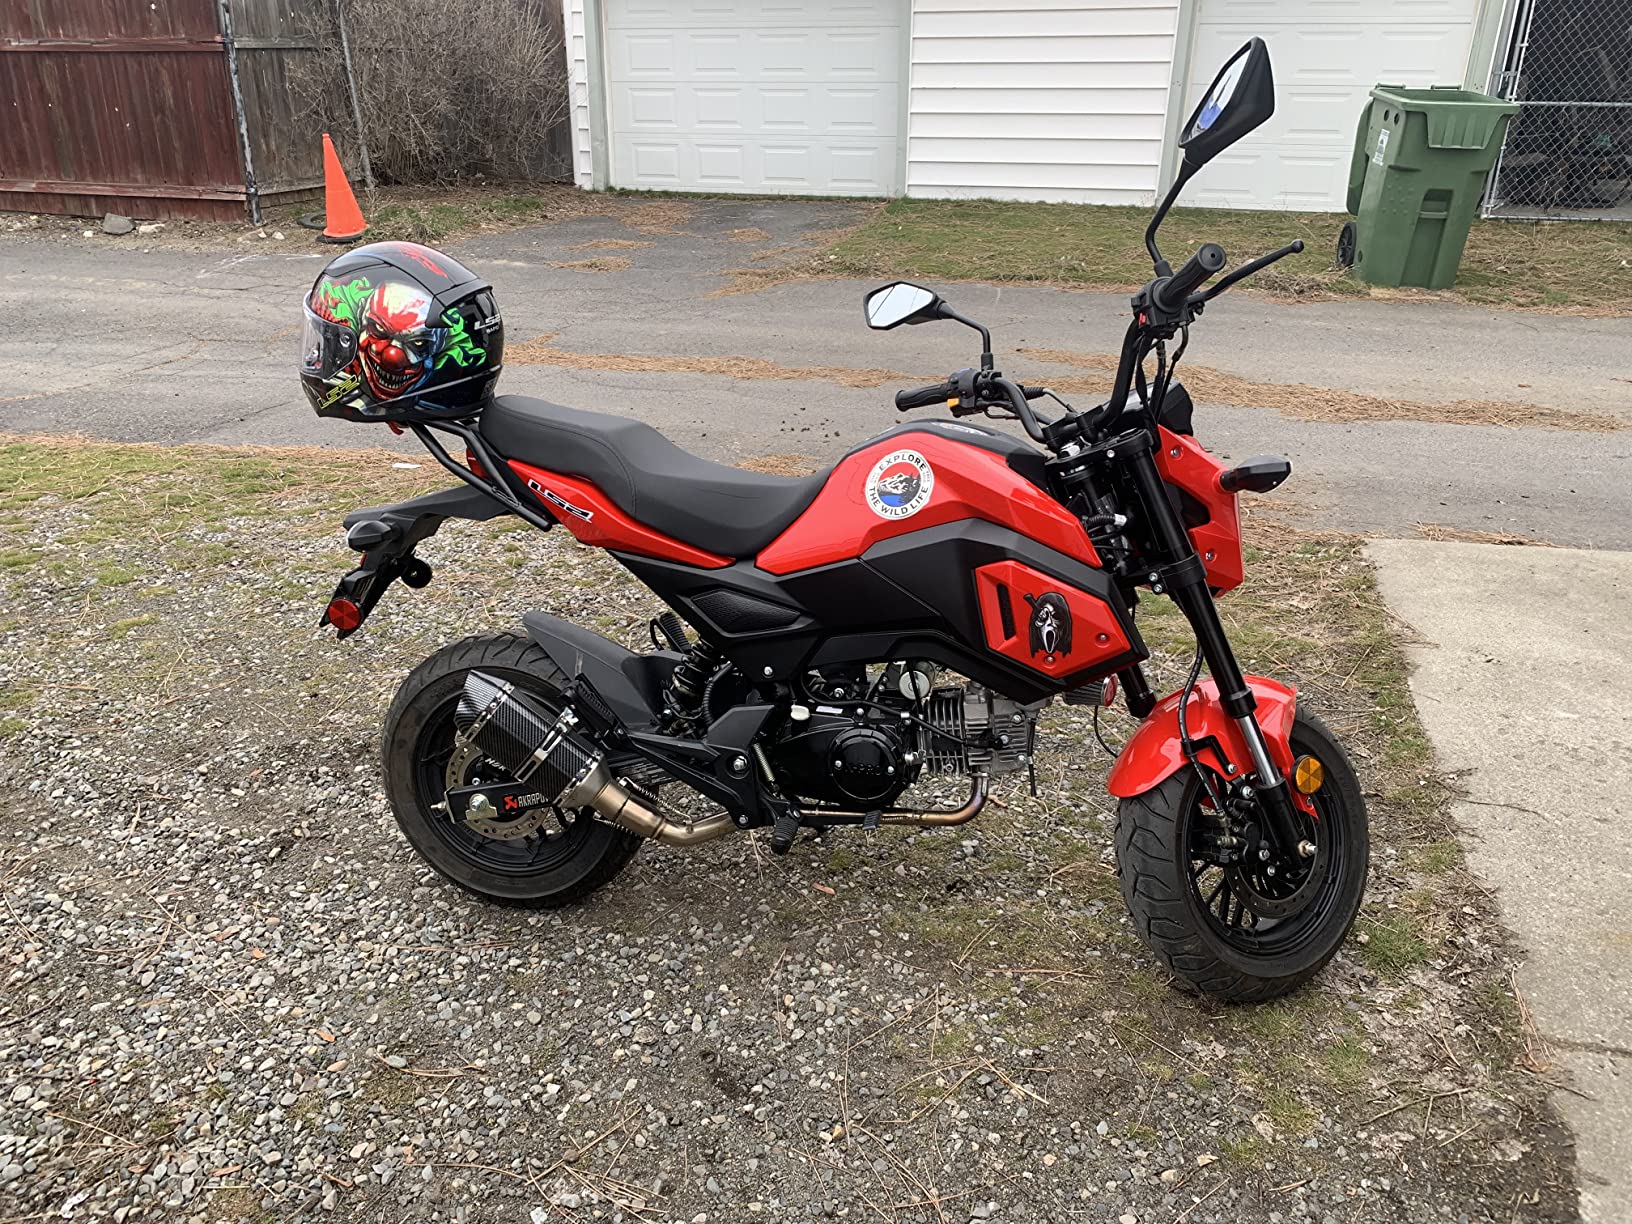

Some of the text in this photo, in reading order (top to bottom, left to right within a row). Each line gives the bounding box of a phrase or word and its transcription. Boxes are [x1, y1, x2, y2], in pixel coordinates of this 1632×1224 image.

[474, 314, 501, 330] LS2
[317, 374, 360, 409] LS2
[878, 454, 927, 471] EXPLORE
[869, 486, 881, 507] THE
